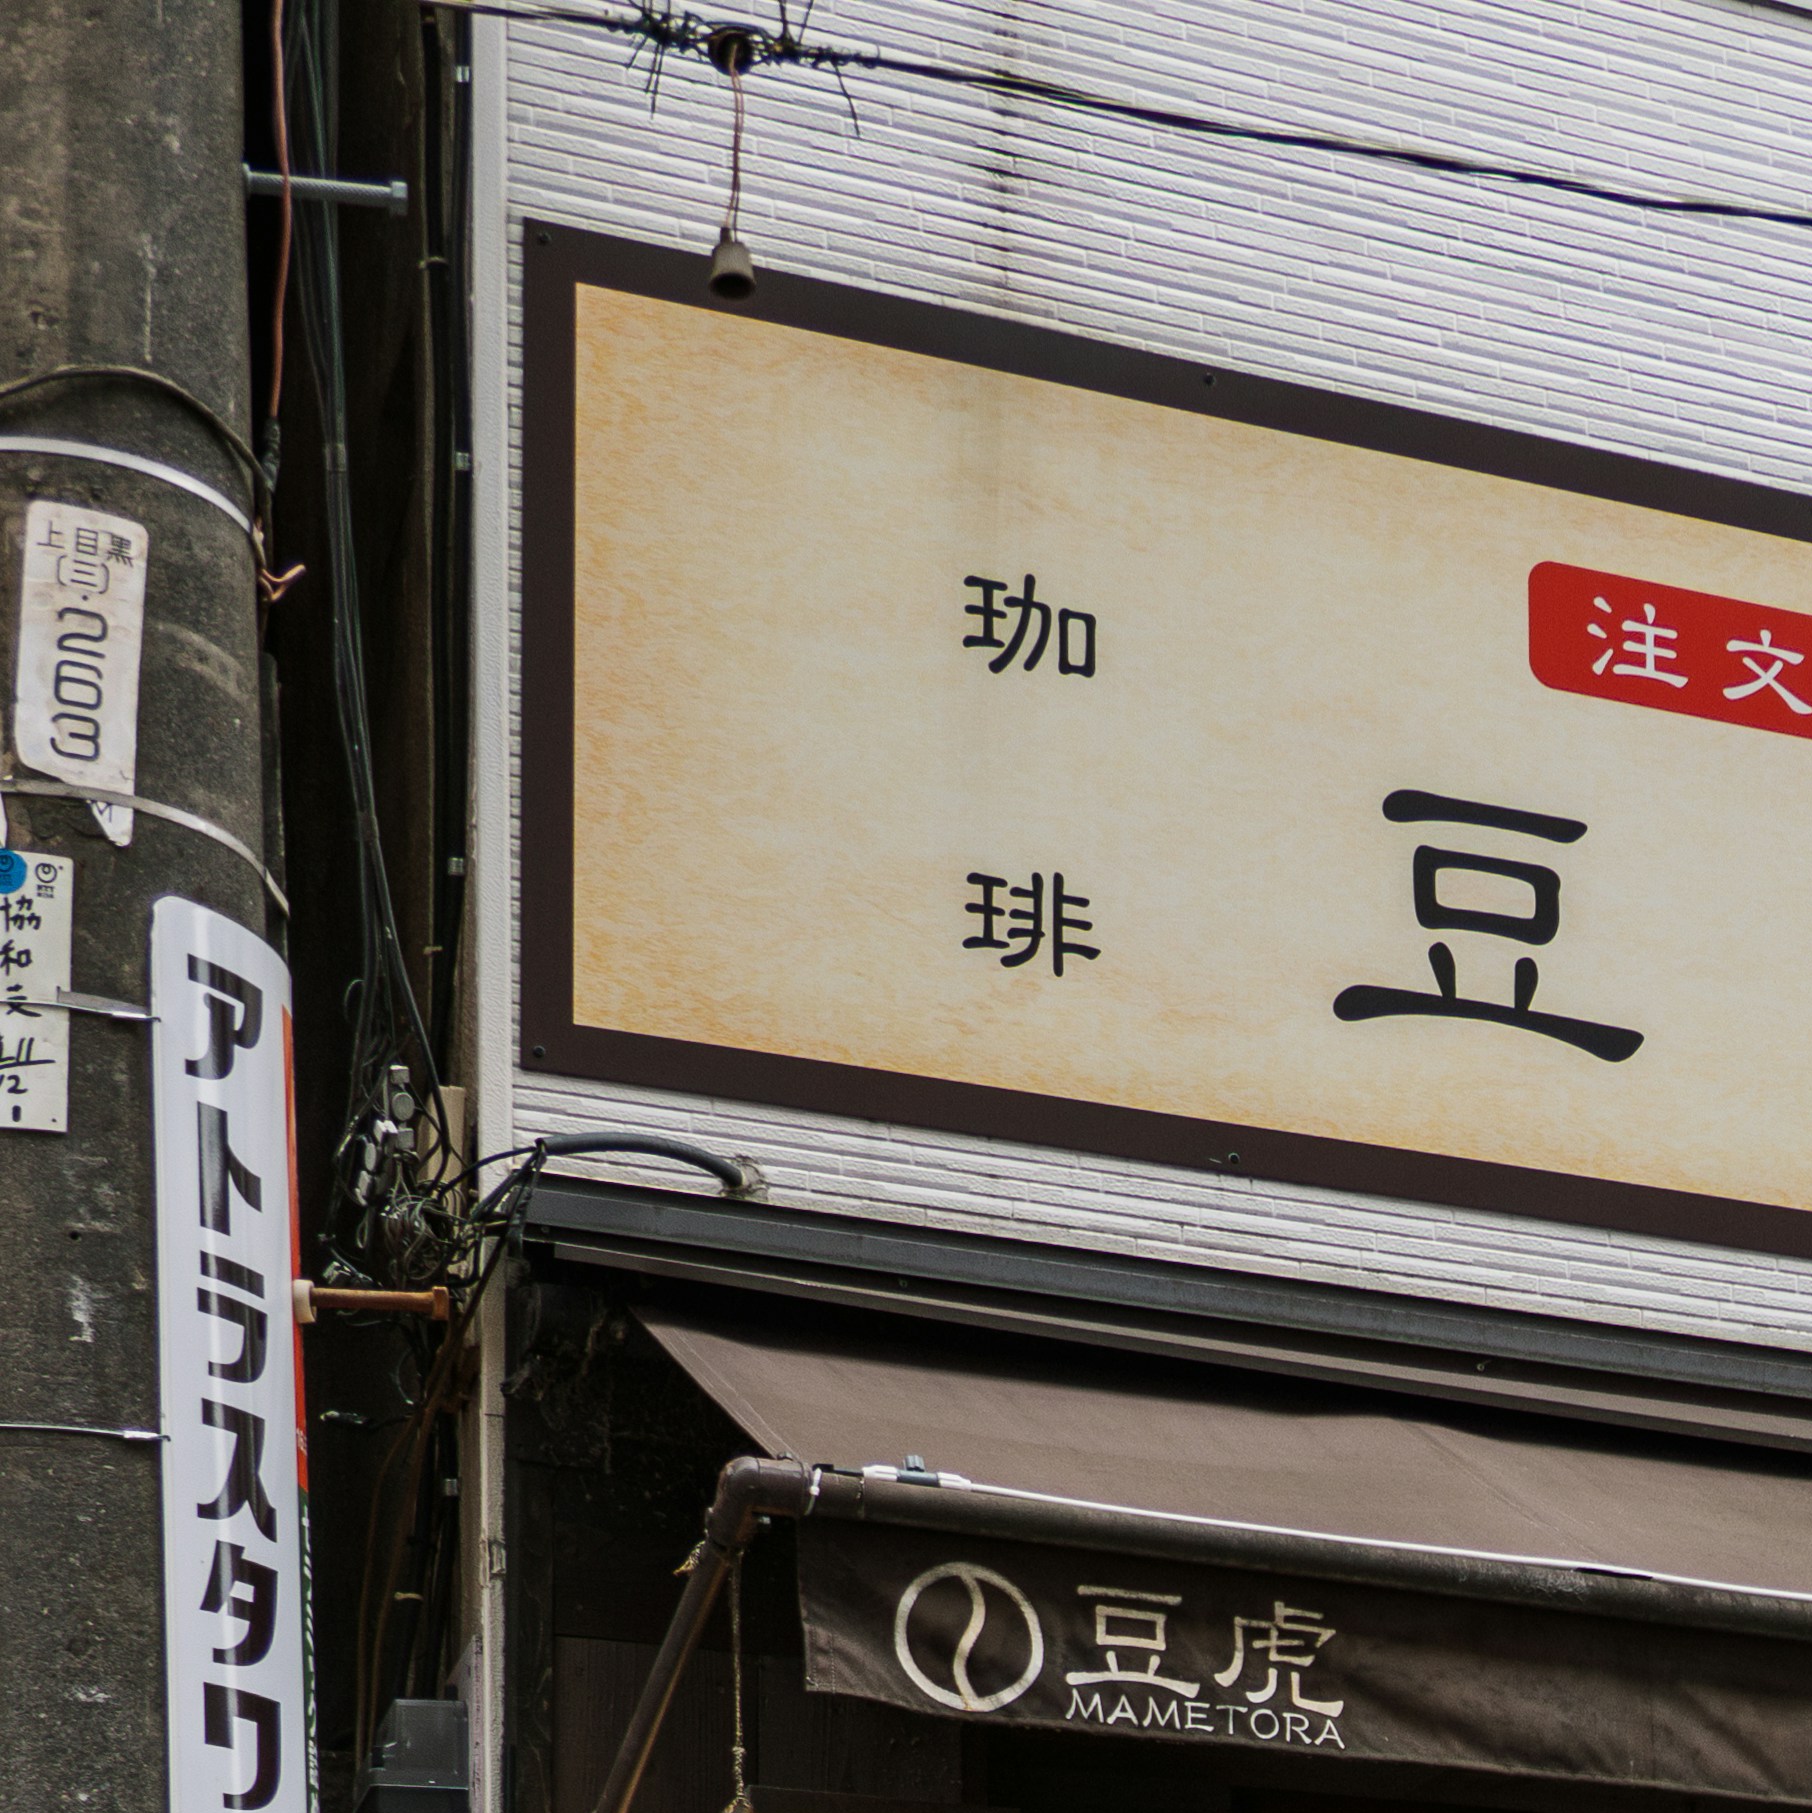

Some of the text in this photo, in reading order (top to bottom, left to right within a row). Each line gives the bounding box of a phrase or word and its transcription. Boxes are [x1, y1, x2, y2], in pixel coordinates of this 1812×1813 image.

[36, 520, 134, 568] 上目黒
[962, 572, 1101, 977] 珈琲
[1065, 1585, 1345, 1717] 豆虎
[1065, 1689, 1346, 1749] MAMETORA
